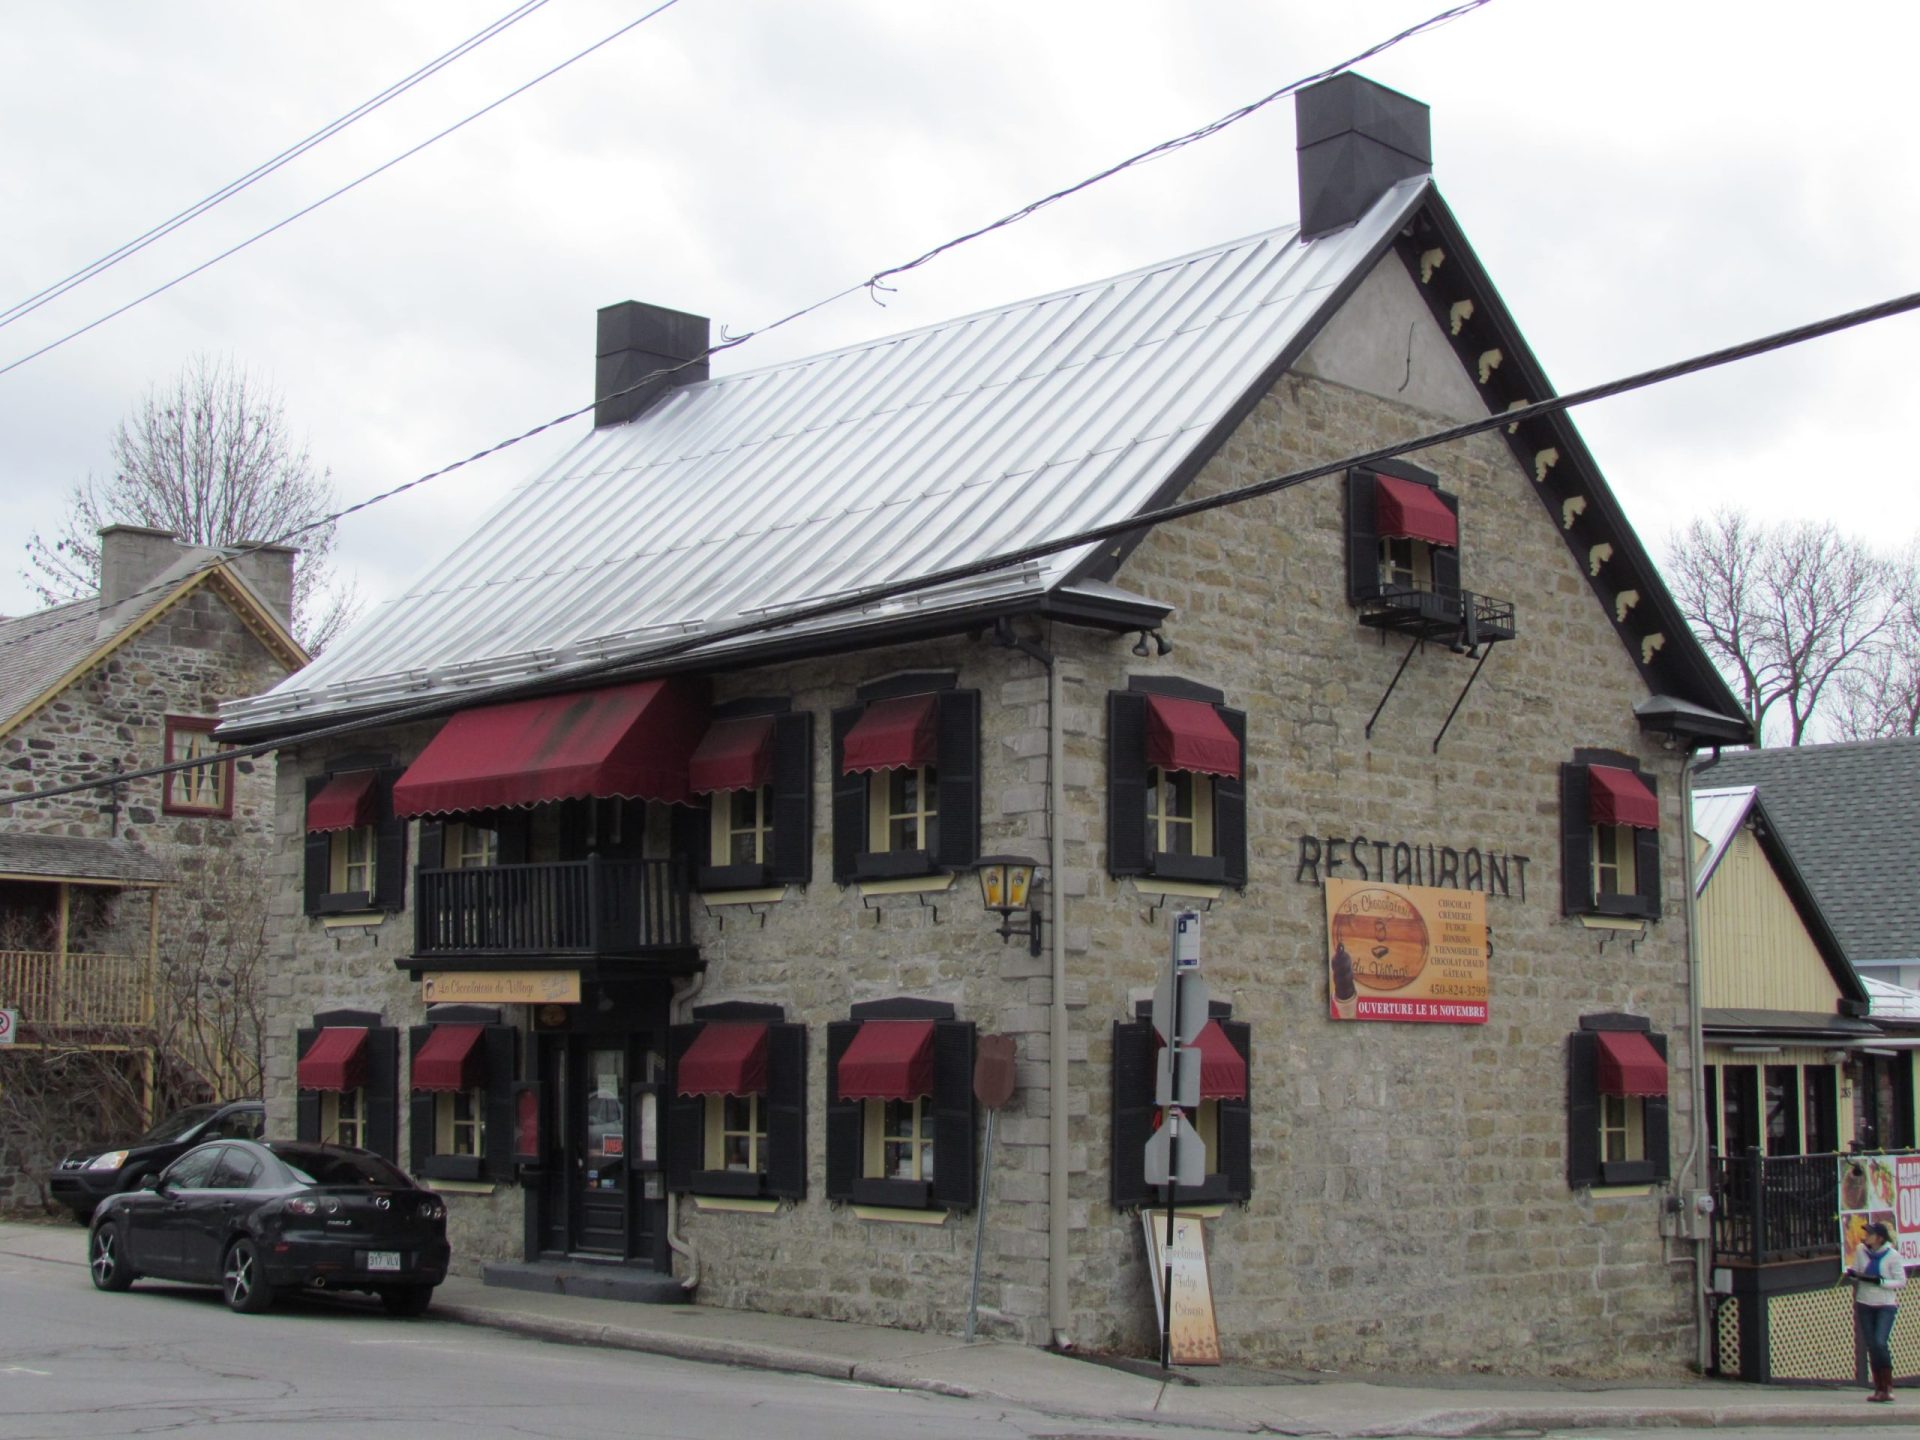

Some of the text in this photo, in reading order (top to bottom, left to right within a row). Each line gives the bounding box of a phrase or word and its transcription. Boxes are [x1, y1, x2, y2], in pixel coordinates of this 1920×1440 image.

[1297, 834, 1530, 904] RESTAURANT
[1438, 899, 1472, 910] CHOCOLAT
[1442, 934, 1472, 944] BONBONS
[1434, 945, 1480, 957] VIENNOISERIE
[1430, 957, 1485, 968] CHOCOLAT CHAUD
[1430, 984, 1486, 997] 450-824-3799
[1358, 1002, 1485, 1017] OUVERTURE LE 16 NOVEMBRE
